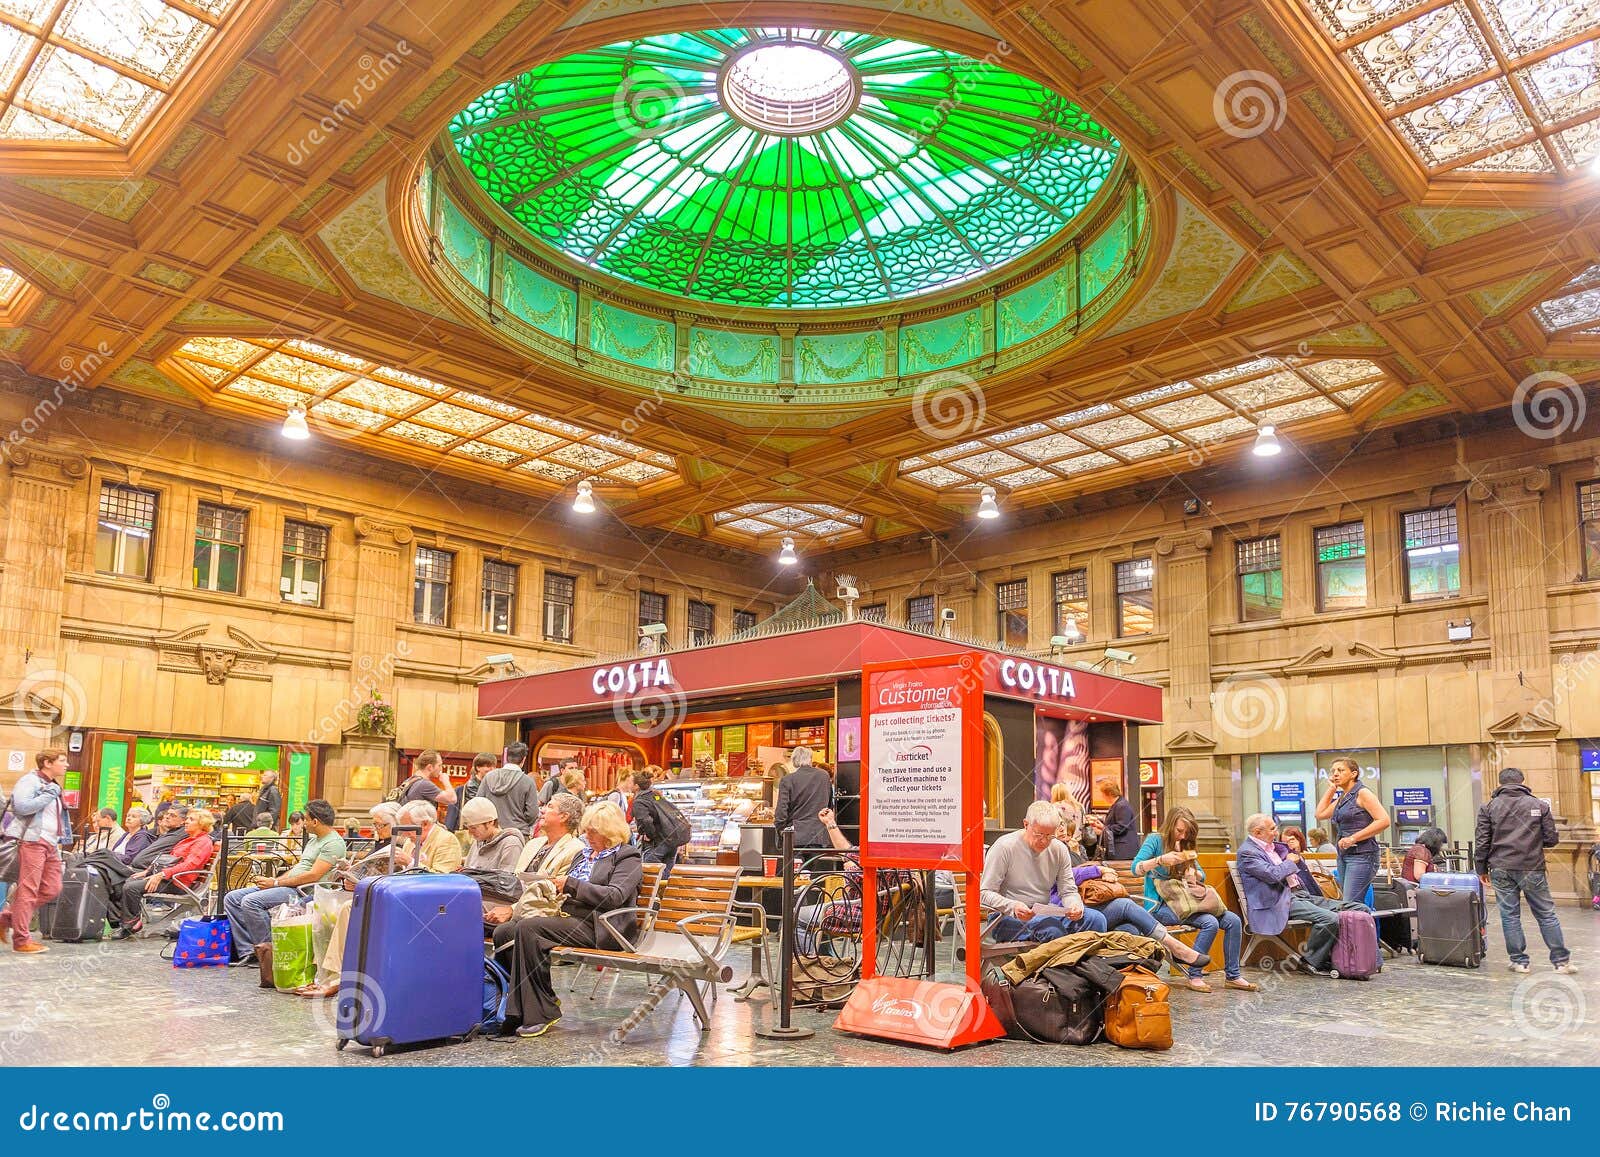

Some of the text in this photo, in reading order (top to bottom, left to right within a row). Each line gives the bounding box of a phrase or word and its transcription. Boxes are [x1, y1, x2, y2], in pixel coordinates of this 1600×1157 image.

[593, 659, 671, 694] COSTA
[1002, 659, 1076, 697] COSTA
[880, 686, 953, 705] Customer
[874, 713, 956, 728] Just collecting tickets?
[159, 742, 256, 763] Whistlestop
